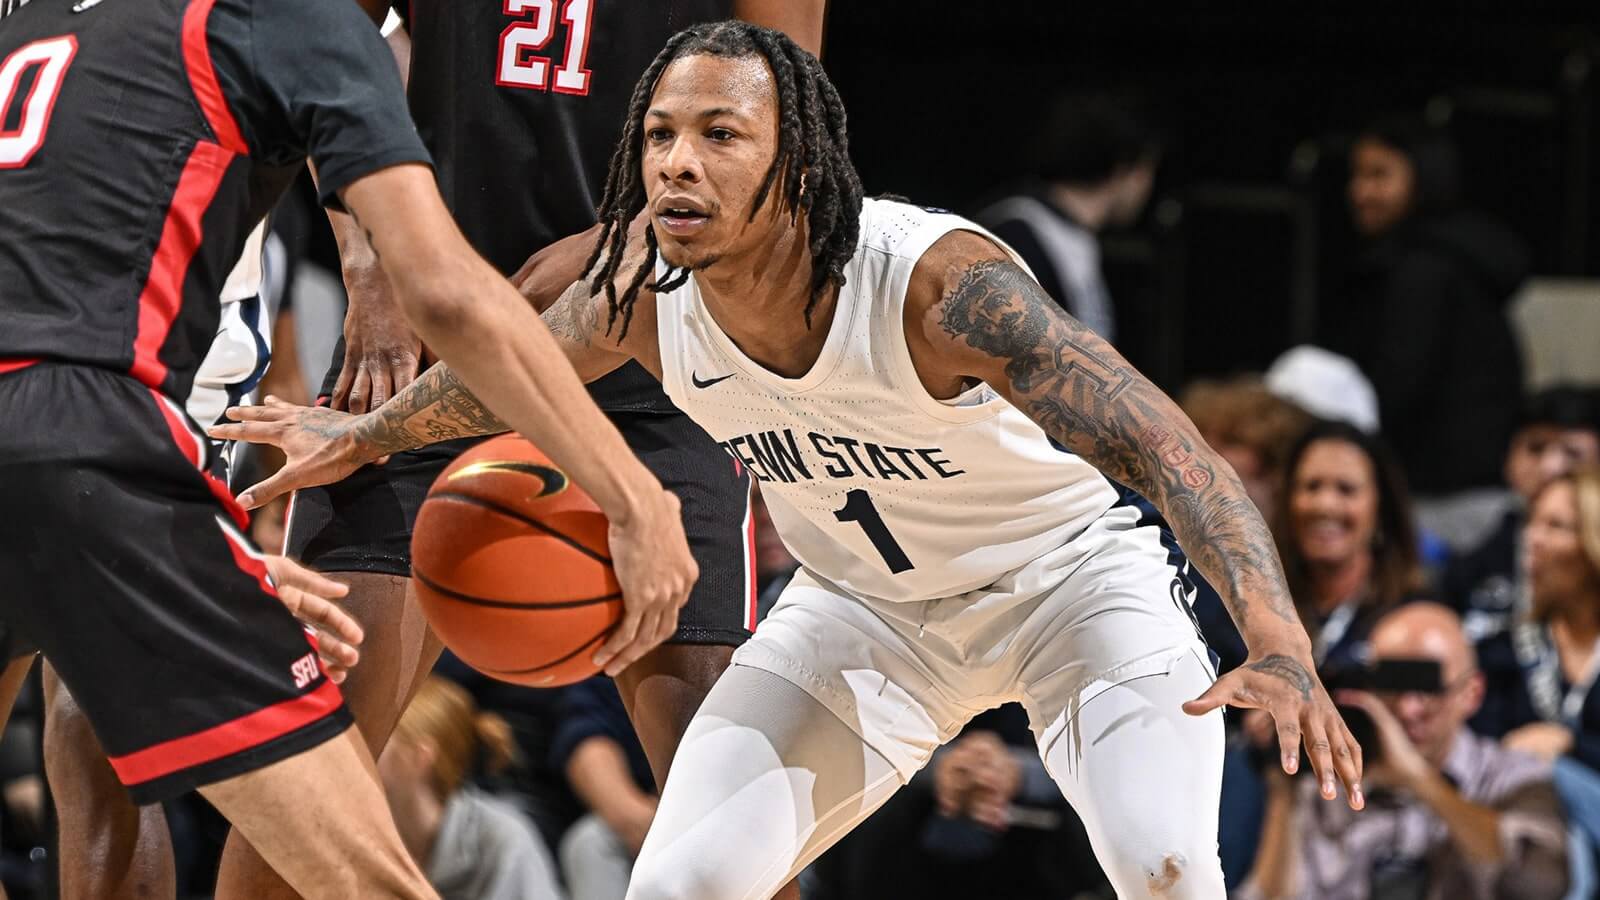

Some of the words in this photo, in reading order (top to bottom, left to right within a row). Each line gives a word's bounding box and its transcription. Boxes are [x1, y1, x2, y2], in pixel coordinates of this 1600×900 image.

[496, 0, 594, 96] 21
[0, 33, 79, 169] 0
[807, 431, 966, 481] STATE
[833, 488, 915, 574] 1
[291, 653, 319, 688] SFU
